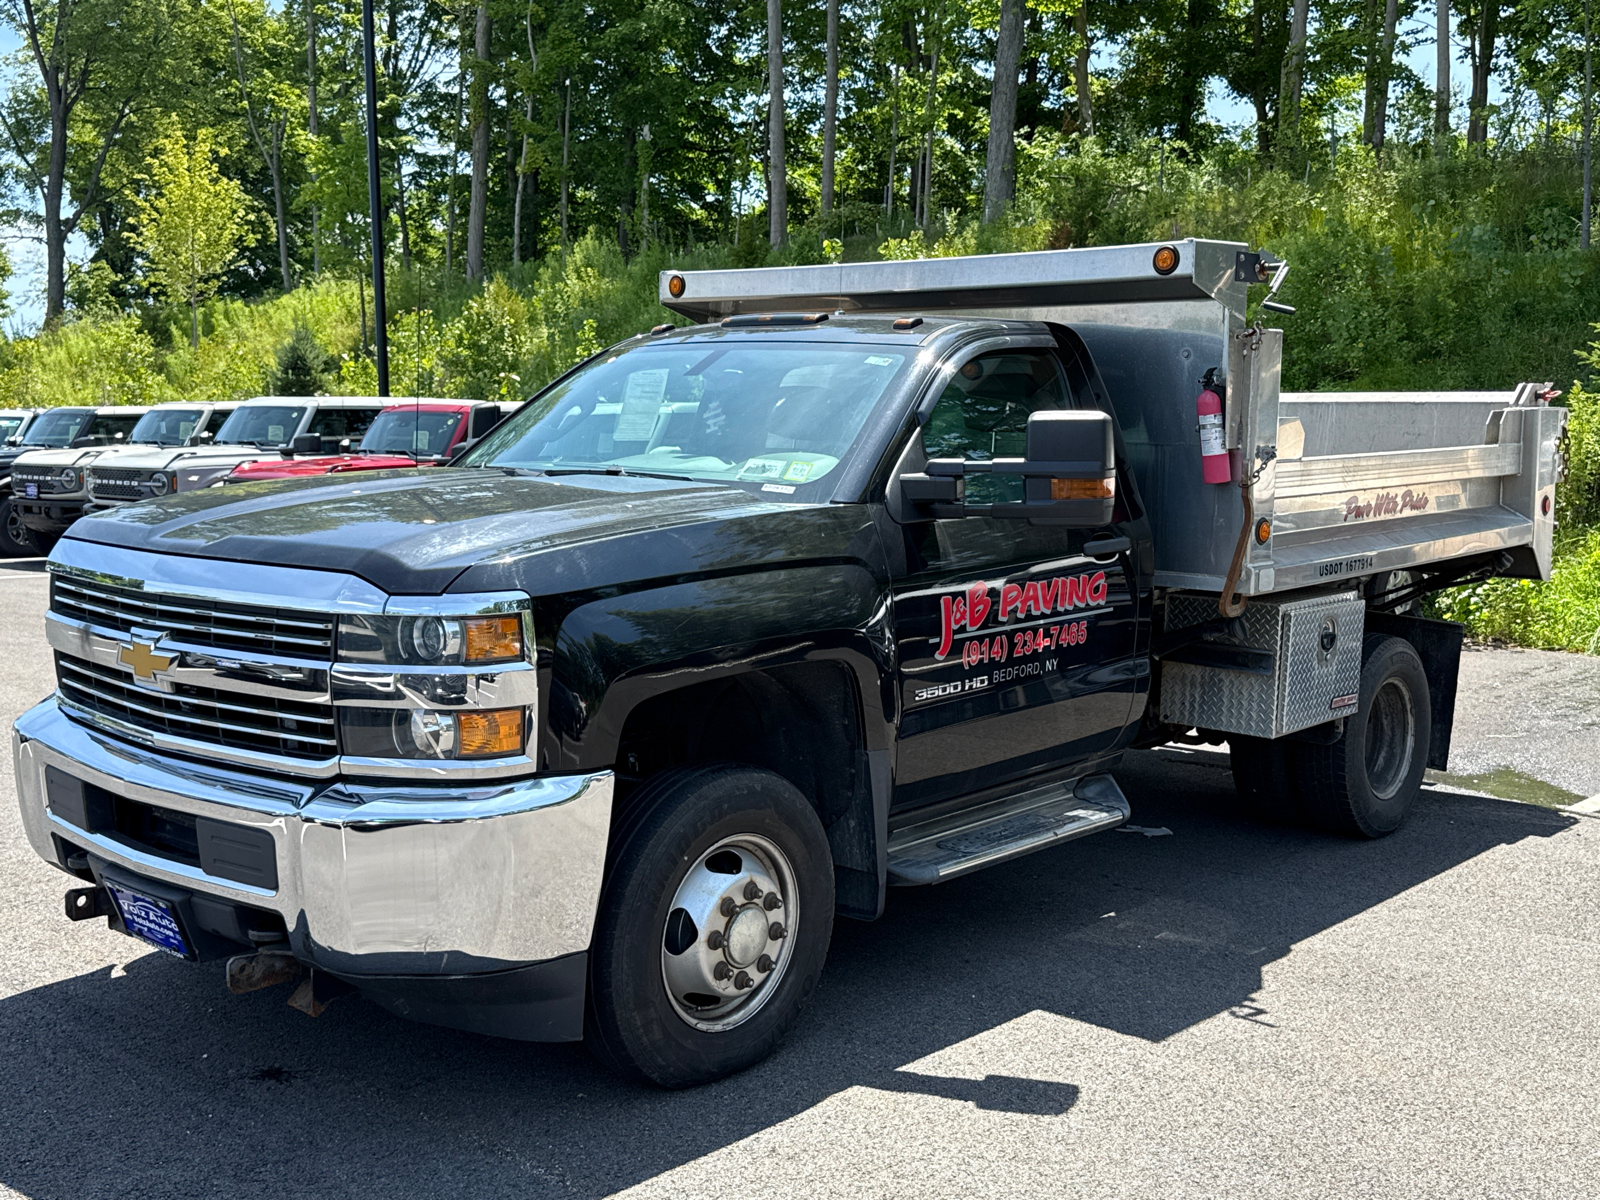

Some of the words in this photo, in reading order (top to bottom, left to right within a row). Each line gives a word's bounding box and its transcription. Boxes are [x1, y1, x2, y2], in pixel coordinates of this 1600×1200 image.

[1343, 495, 1373, 522] Pave
[1373, 492, 1399, 517] With
[1400, 489, 1429, 515] Pride
[1320, 562, 1343, 577] USDOT
[1345, 557, 1373, 573] 1677914
[934, 580, 992, 661] J&B
[998, 571, 1108, 622] PAVING
[962, 634, 1008, 669] (914)
[1014, 621, 1087, 657] 234-7465
[993, 663, 1043, 684] BEDFORD,
[1045, 658, 1059, 671] NY
[915, 680, 962, 701] 3500
[964, 675, 989, 690] HD
[120, 901, 147, 918] Volz
[149, 911, 179, 931] Auto
